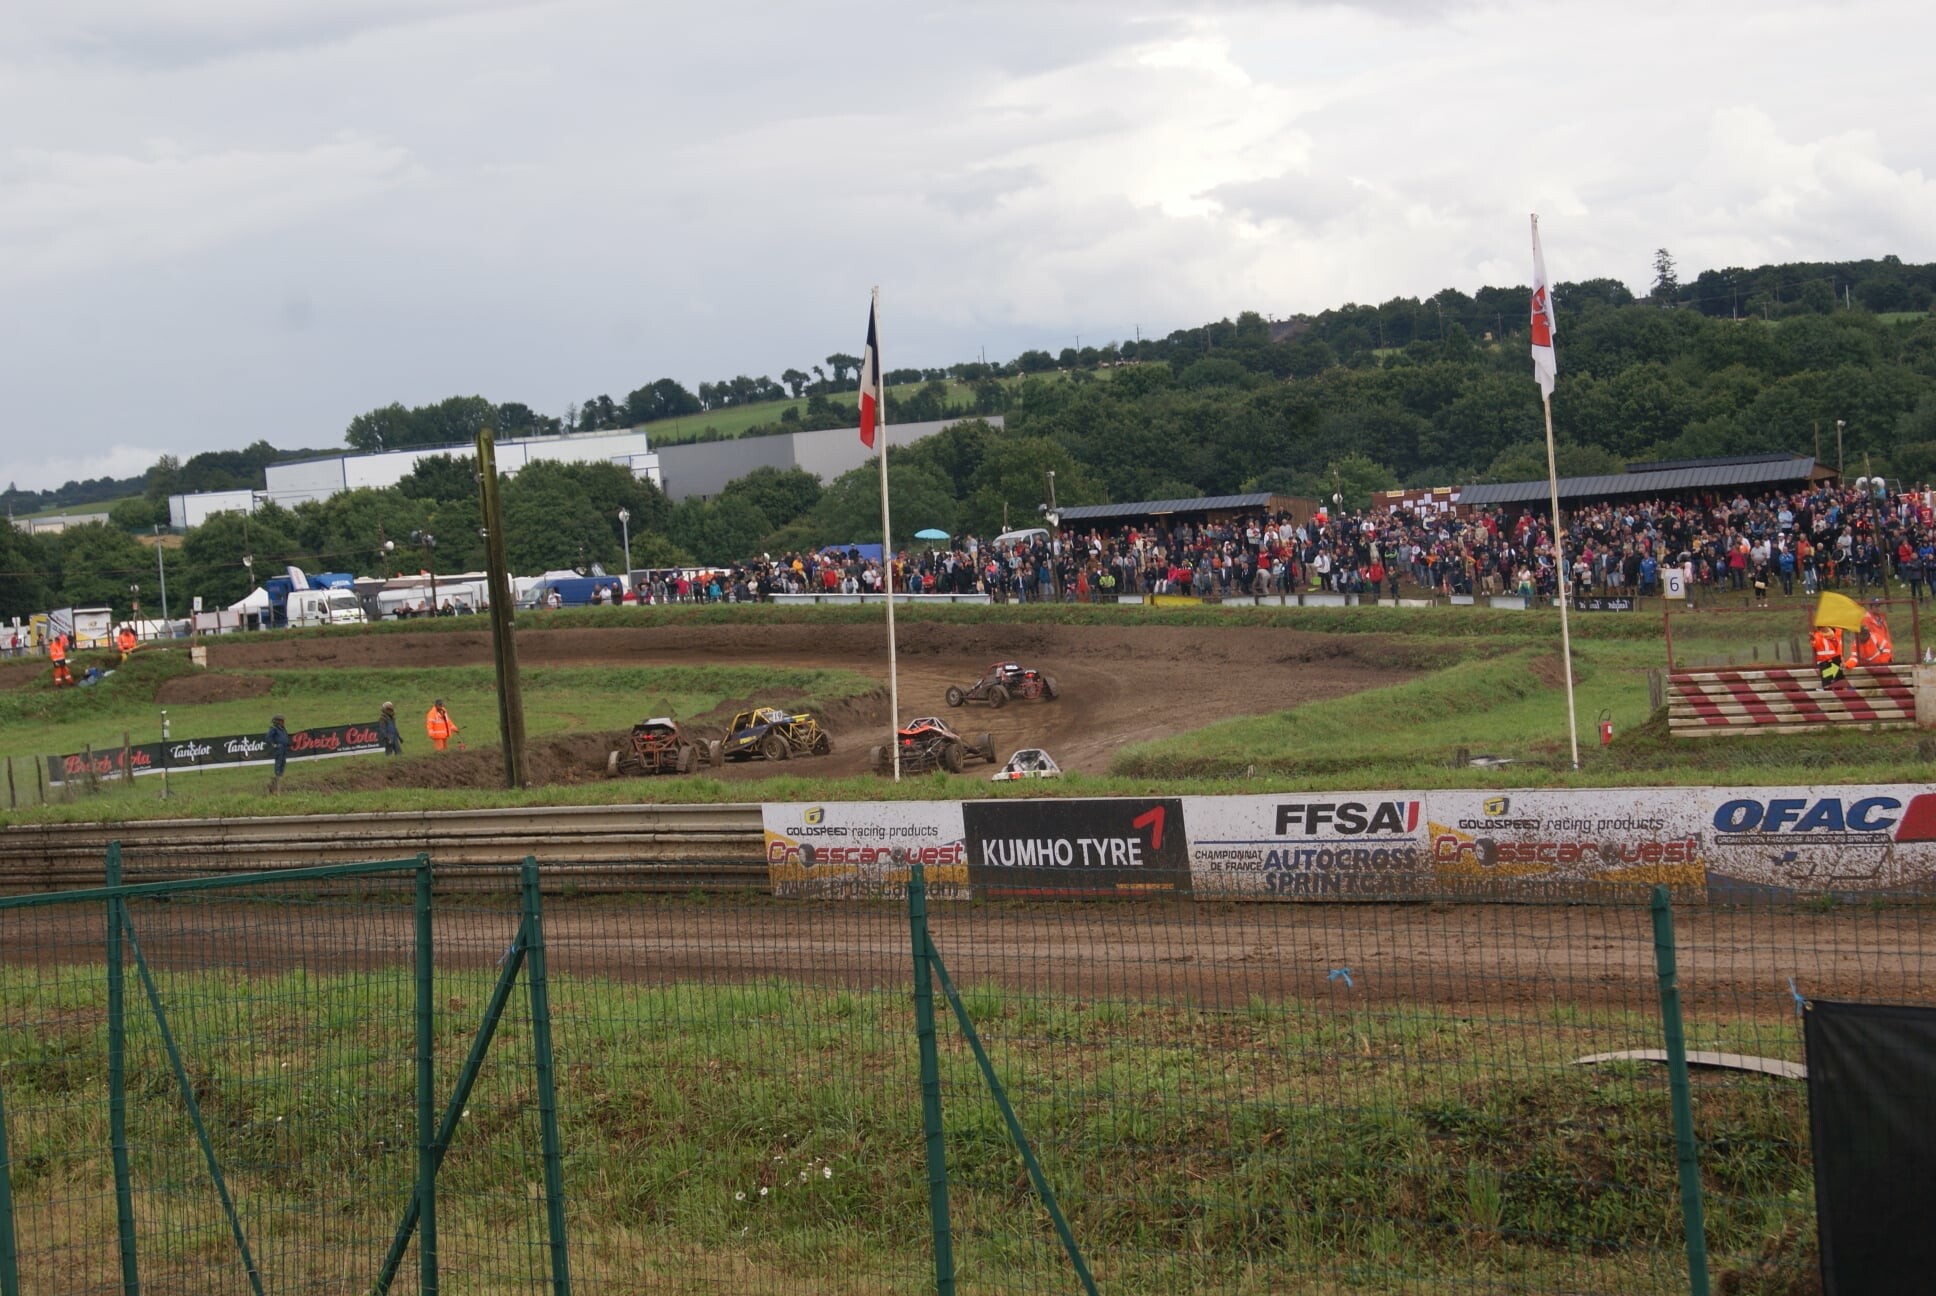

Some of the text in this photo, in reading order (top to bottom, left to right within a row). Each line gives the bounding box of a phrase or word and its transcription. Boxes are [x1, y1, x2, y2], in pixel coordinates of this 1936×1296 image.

[1669, 576, 1680, 592] 6
[290, 731, 341, 751] Breizh
[345, 727, 379, 745] Cola
[1275, 801, 1404, 836] FFSA
[1713, 796, 1902, 832] OFAC
[786, 824, 938, 840] GOLDSPEED racing products
[1459, 815, 1664, 833] GOLDSPEED racing products
[1846, 834, 1873, 843] SPRINT
[981, 837, 1144, 867] KUMHO TYRE
[1195, 850, 1263, 861] CHAMPIONNAT
[1263, 849, 1417, 871] AUTOCROSS
[1210, 861, 1262, 871] DE FRANCE
